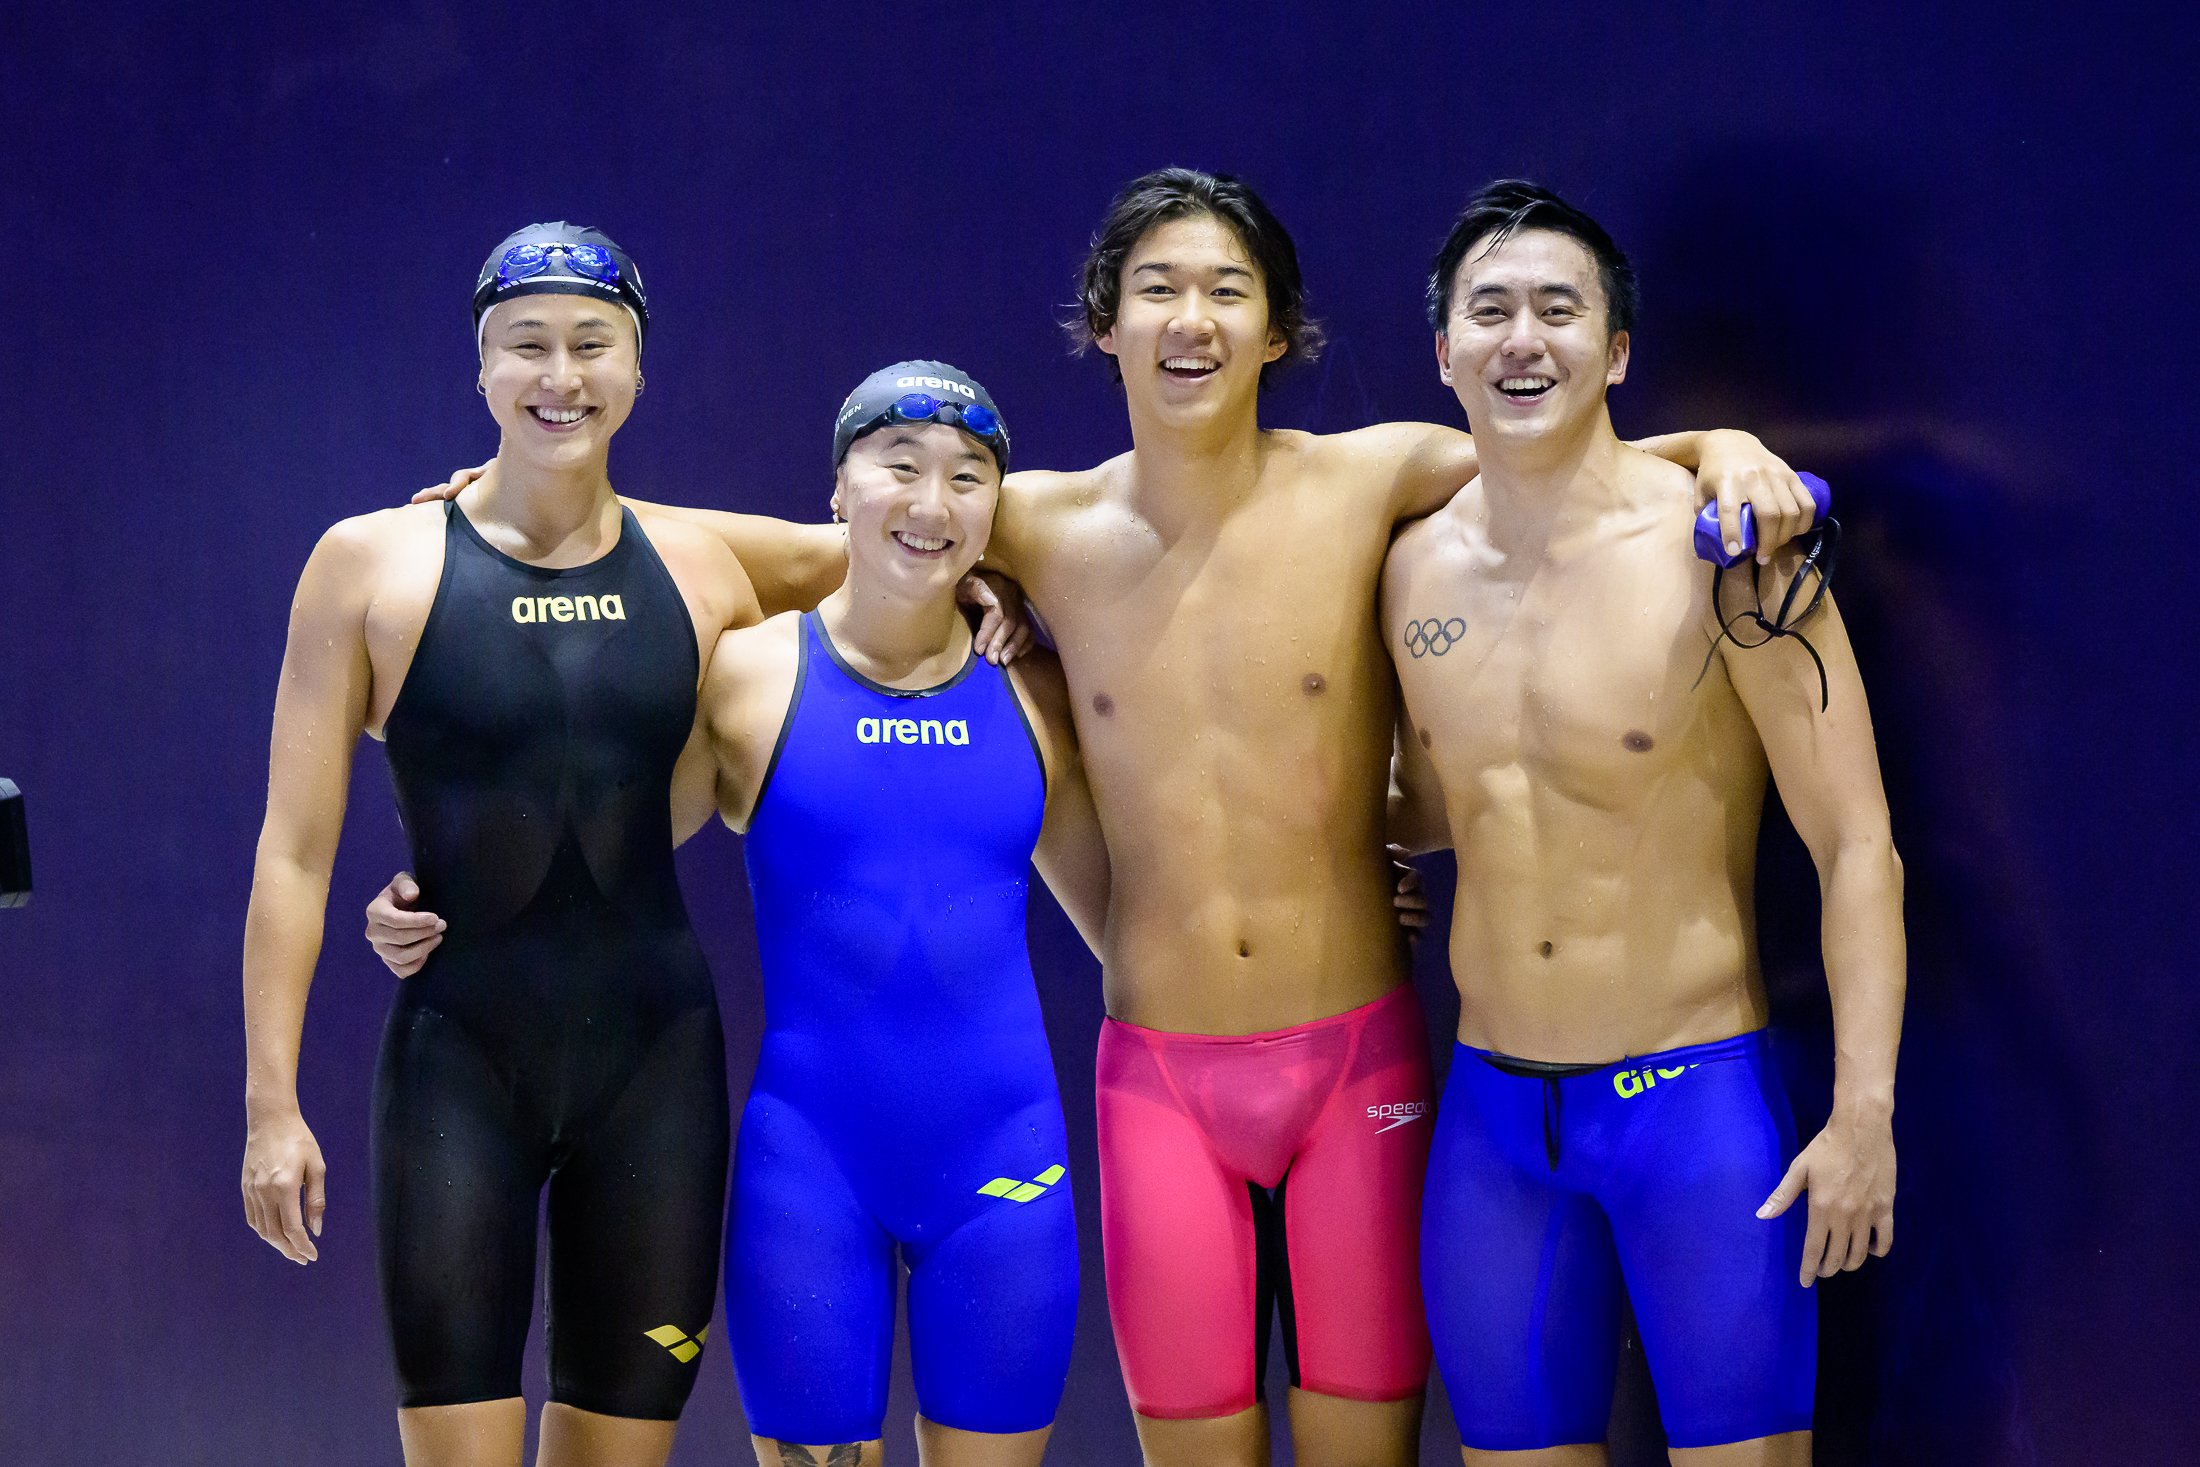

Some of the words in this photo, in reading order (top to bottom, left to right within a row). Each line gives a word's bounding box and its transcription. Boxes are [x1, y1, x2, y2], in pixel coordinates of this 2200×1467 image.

[896, 376, 976, 400] arena
[840, 402, 862, 424] WEN
[511, 594, 626, 624] arena
[856, 717, 970, 746] arena
[1366, 1099, 1431, 1120] speedo
